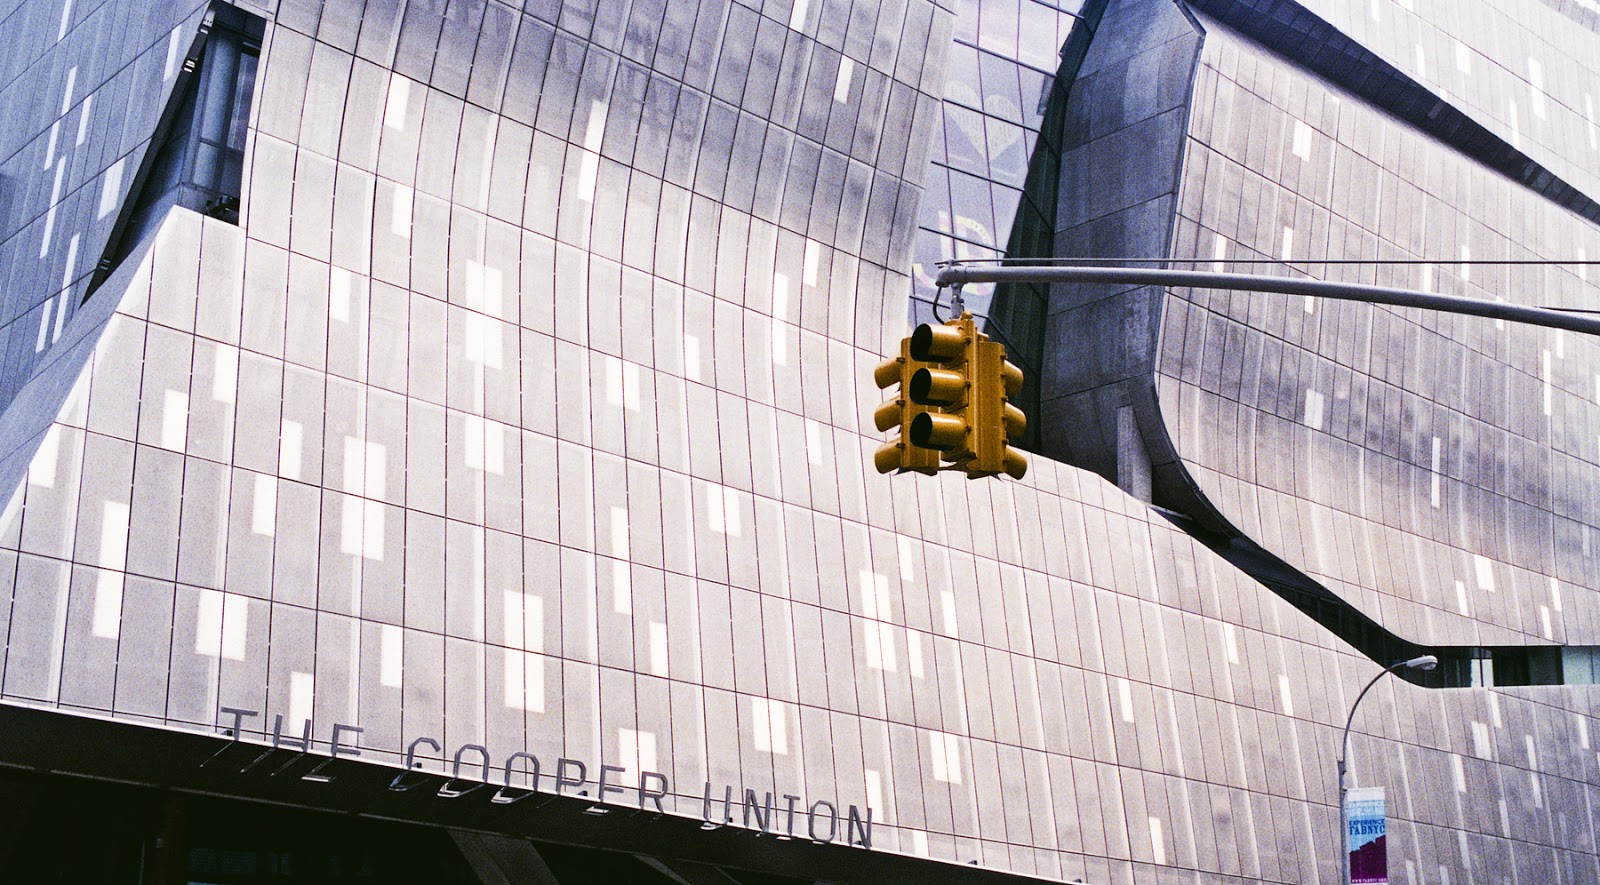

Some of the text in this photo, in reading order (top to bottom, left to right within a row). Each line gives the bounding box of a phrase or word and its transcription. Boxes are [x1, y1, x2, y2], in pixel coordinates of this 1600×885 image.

[219, 707, 872, 849] THE COOPER UNION
[1350, 825, 1386, 835] FABNYC
